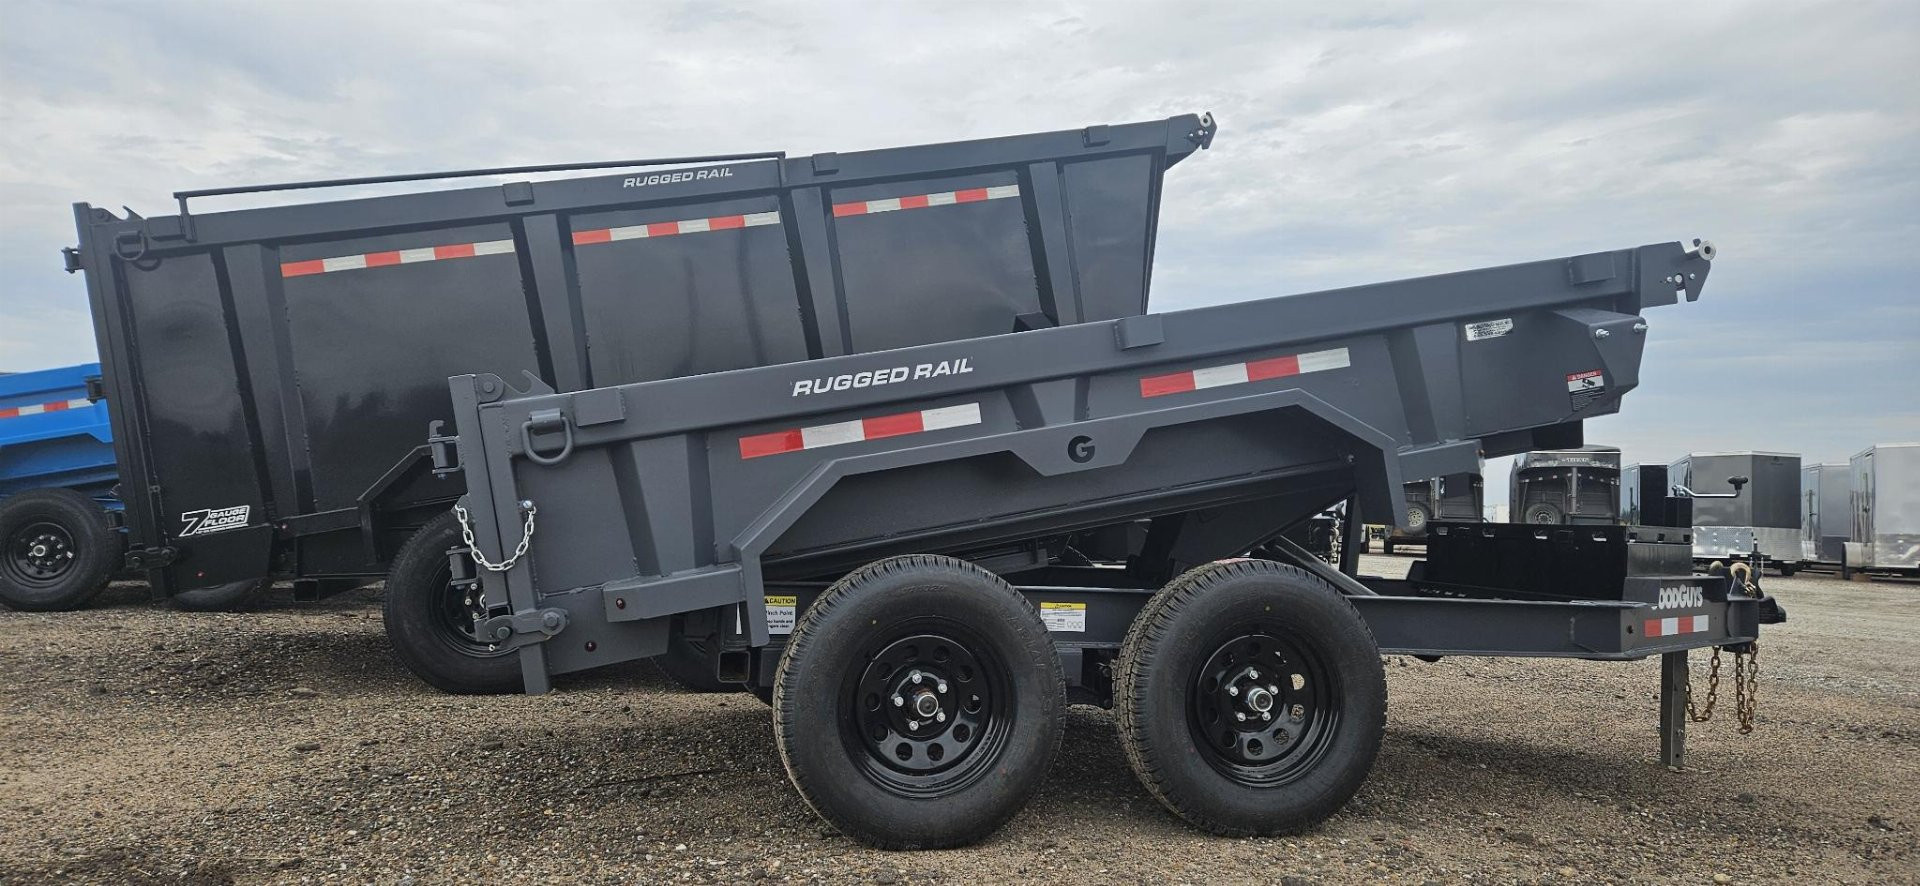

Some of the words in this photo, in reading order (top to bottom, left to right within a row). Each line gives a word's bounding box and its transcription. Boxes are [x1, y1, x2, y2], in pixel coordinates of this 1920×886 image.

[623, 171, 694, 188] RUGGED
[696, 167, 733, 180] RAIL
[792, 366, 910, 397] RUGGED
[913, 357, 974, 380] RAIL
[1067, 435, 1096, 464] G
[178, 508, 211, 537] 7
[204, 514, 246, 527] FLOOR
[209, 507, 247, 519] GAUGE
[1651, 583, 1704, 610] OODGUYS
